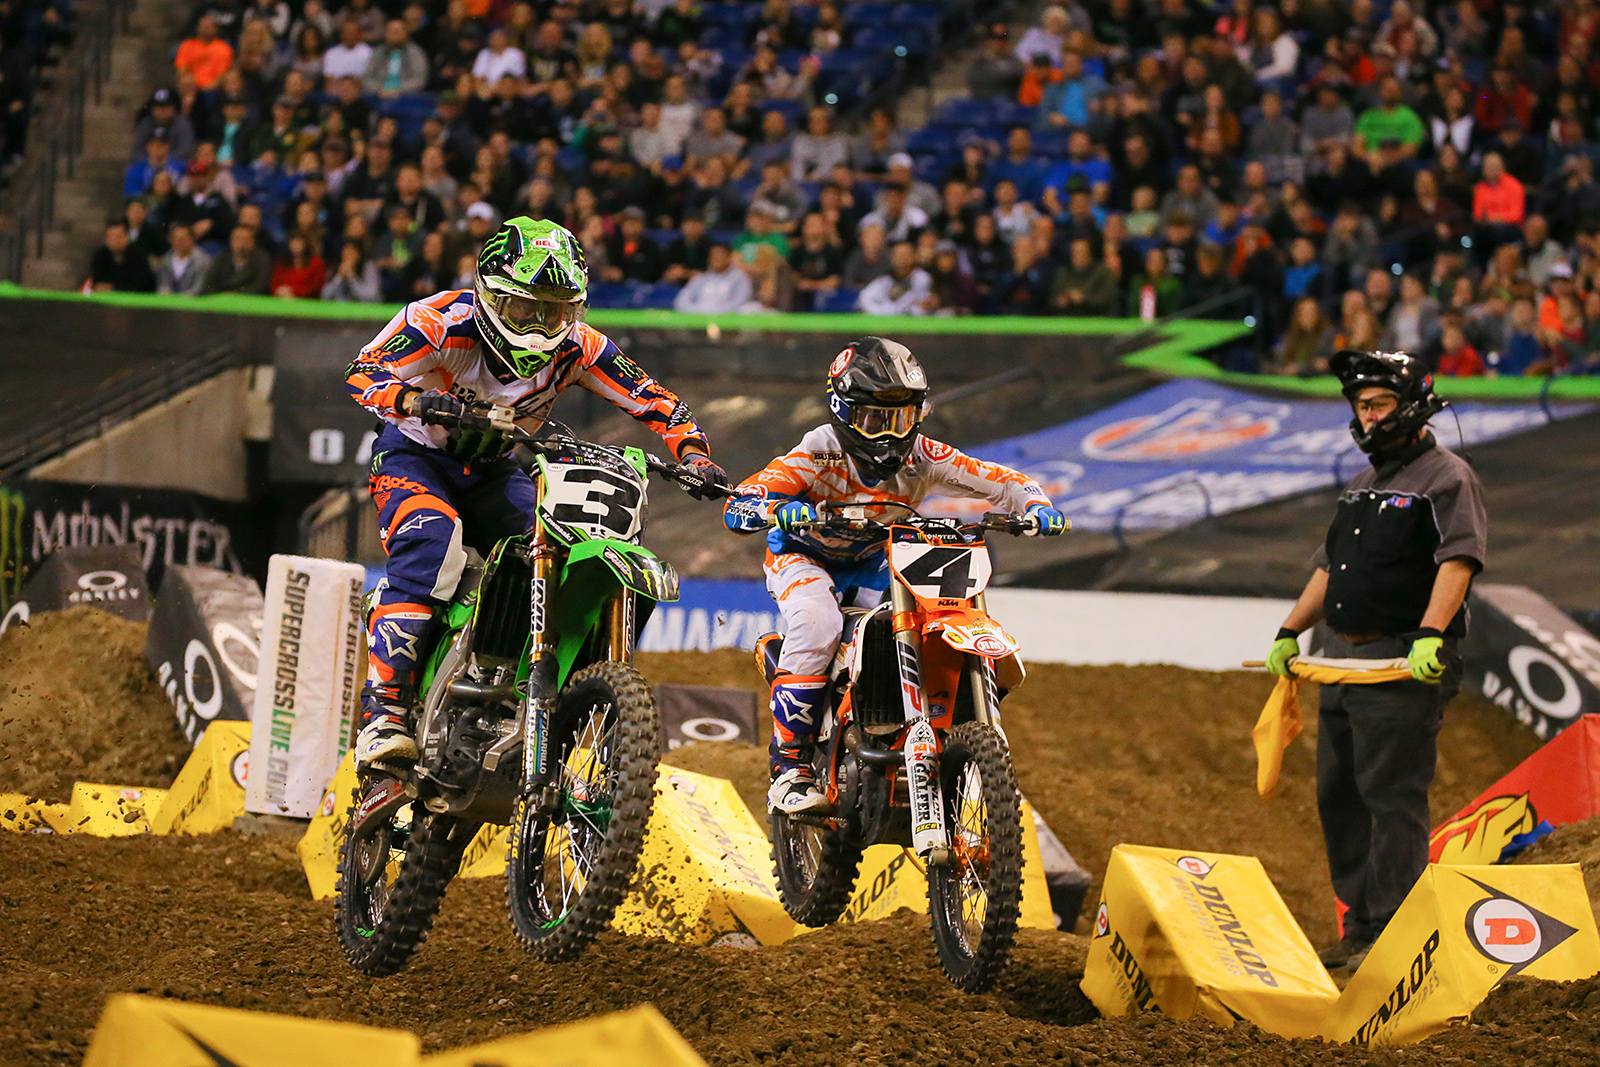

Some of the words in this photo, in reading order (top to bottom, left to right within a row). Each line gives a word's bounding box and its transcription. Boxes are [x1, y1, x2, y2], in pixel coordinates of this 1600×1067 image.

[541, 512, 575, 542] Kawasaki
[552, 468, 641, 535] 3
[32, 500, 243, 578] MONSTER
[899, 547, 977, 599] 4
[937, 599, 959, 607] KTM
[337, 577, 362, 758] SUPERCROSSLIVE
[540, 730, 550, 775] CARRILLO
[913, 762, 931, 823] GALFER
[511, 795, 526, 859] DUNLO
[1191, 881, 1279, 988] DUNLOP
[1484, 917, 1537, 946] D
[1109, 931, 1162, 1013] DUNL
[1350, 928, 1440, 1046] UNLOP
